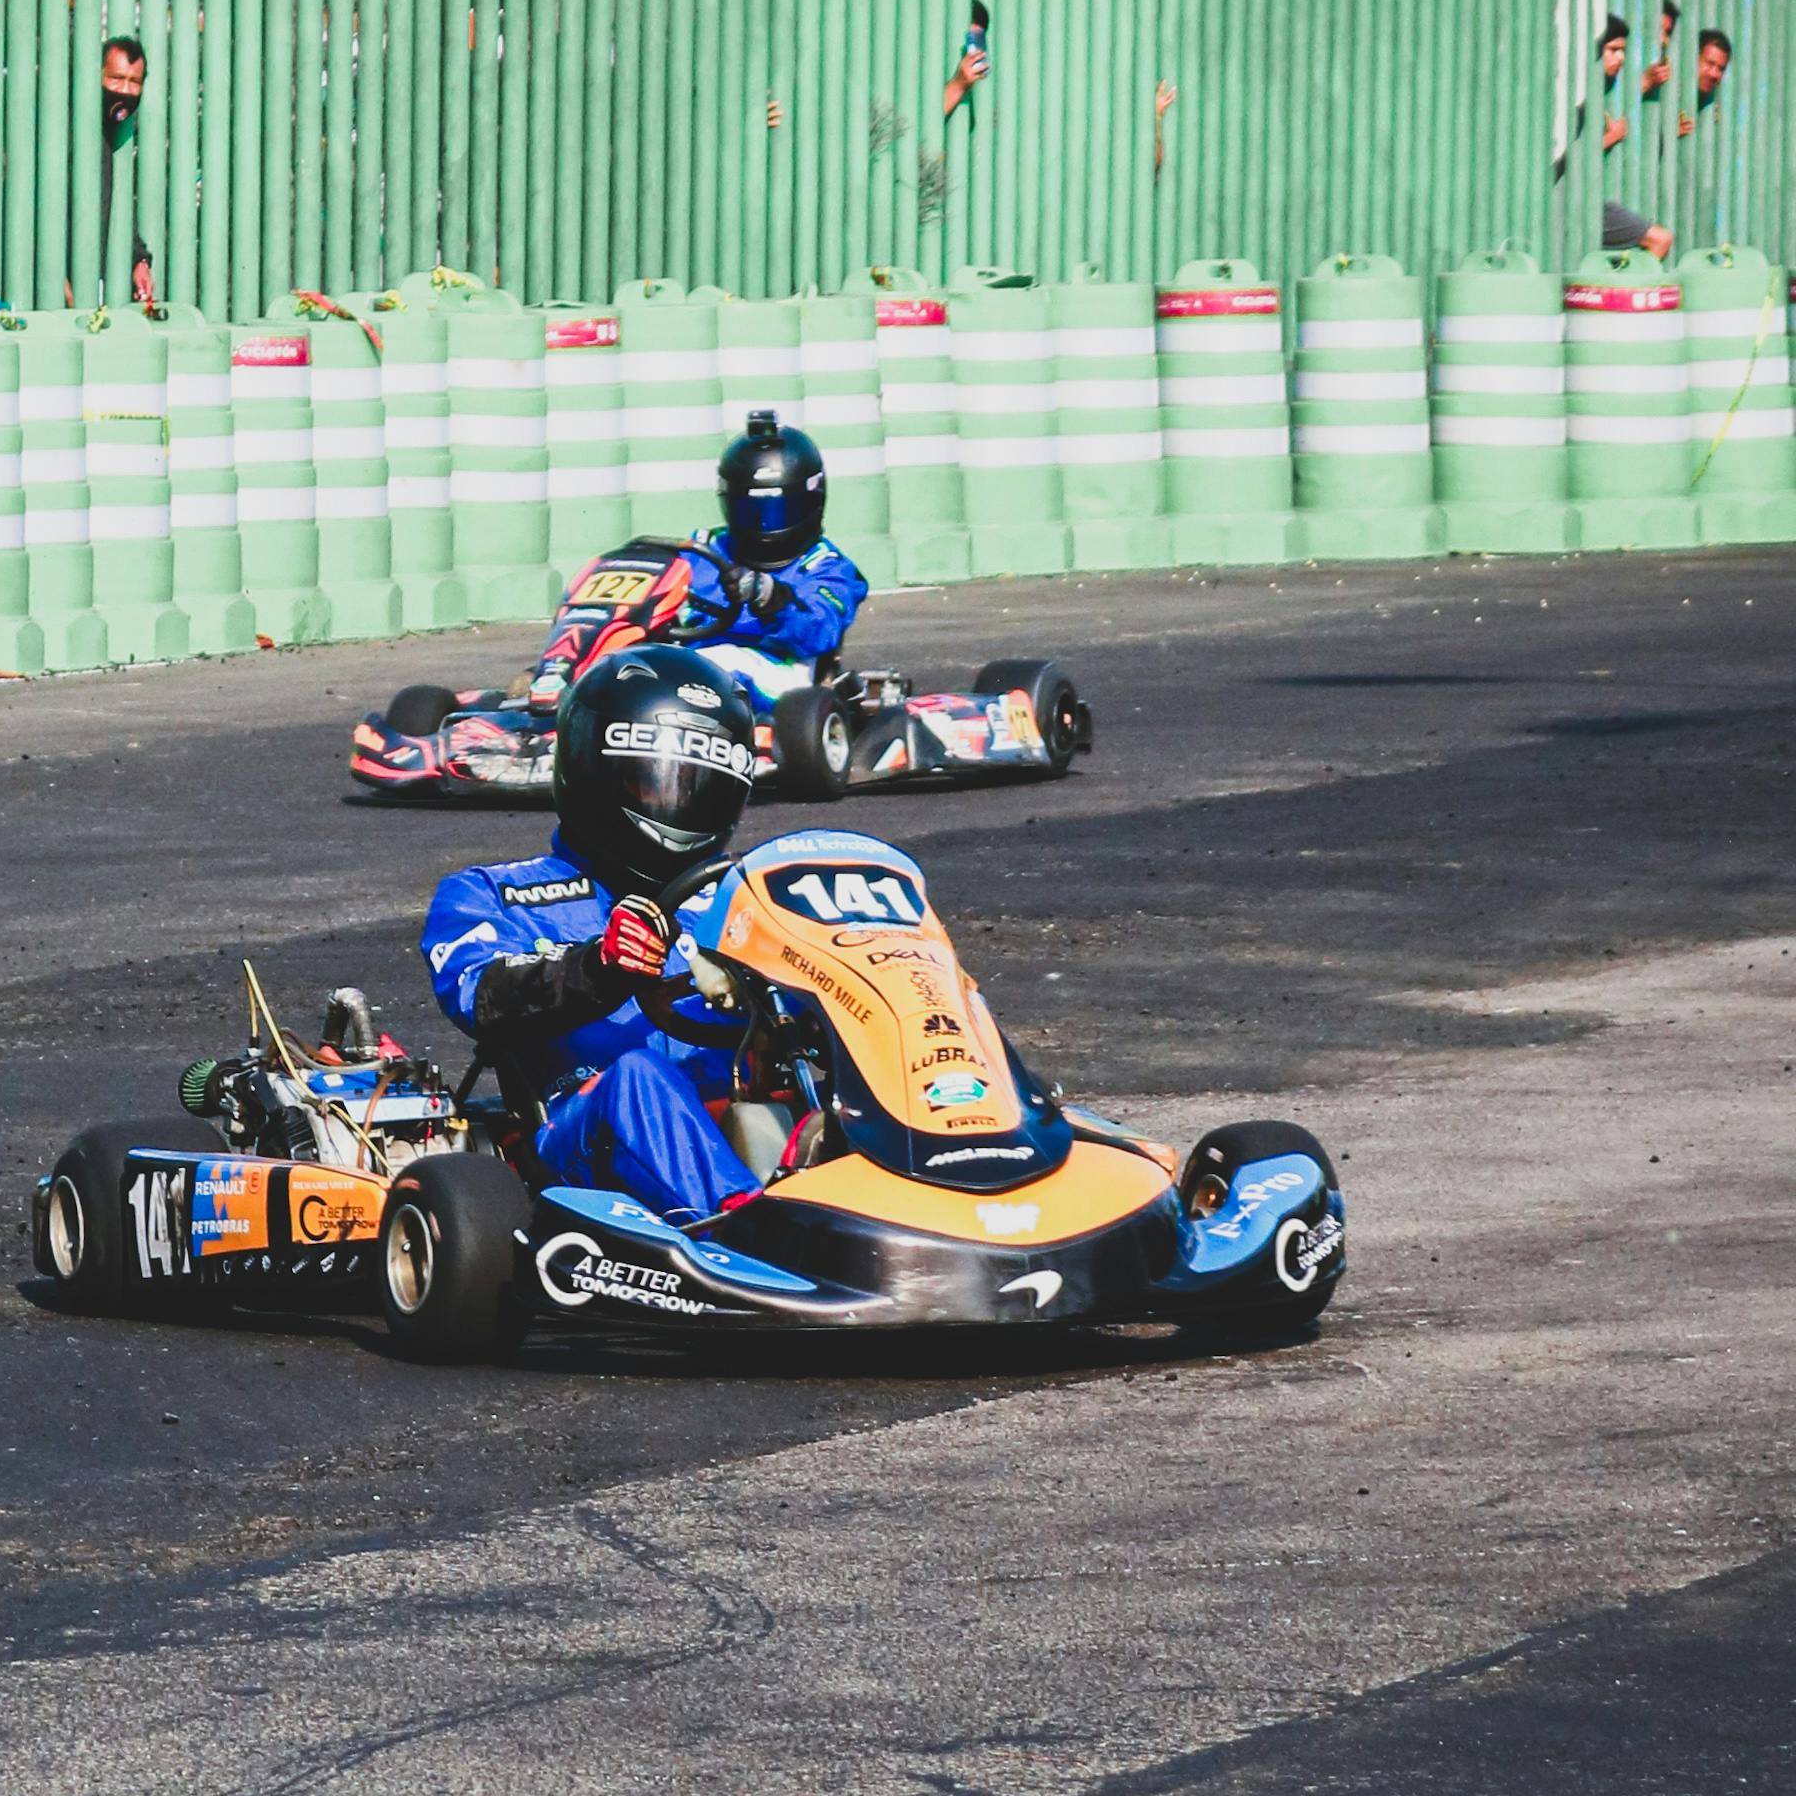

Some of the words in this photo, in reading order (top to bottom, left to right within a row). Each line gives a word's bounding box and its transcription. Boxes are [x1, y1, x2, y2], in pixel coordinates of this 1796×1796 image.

[586, 574, 646, 599] 127
[604, 721, 757, 780] GEARBOX
[787, 873, 922, 923] 141
[780, 945, 835, 993] RICHARD
[834, 985, 873, 1025] MILLE
[194, 1178, 247, 1197] RENAULT
[191, 1218, 251, 1236] PETROBRAS
[327, 1206, 365, 1219] BETTER
[573, 1255, 593, 1274] A
[595, 1258, 683, 1293] BETTER
[570, 1273, 705, 1316] TOMORROW
